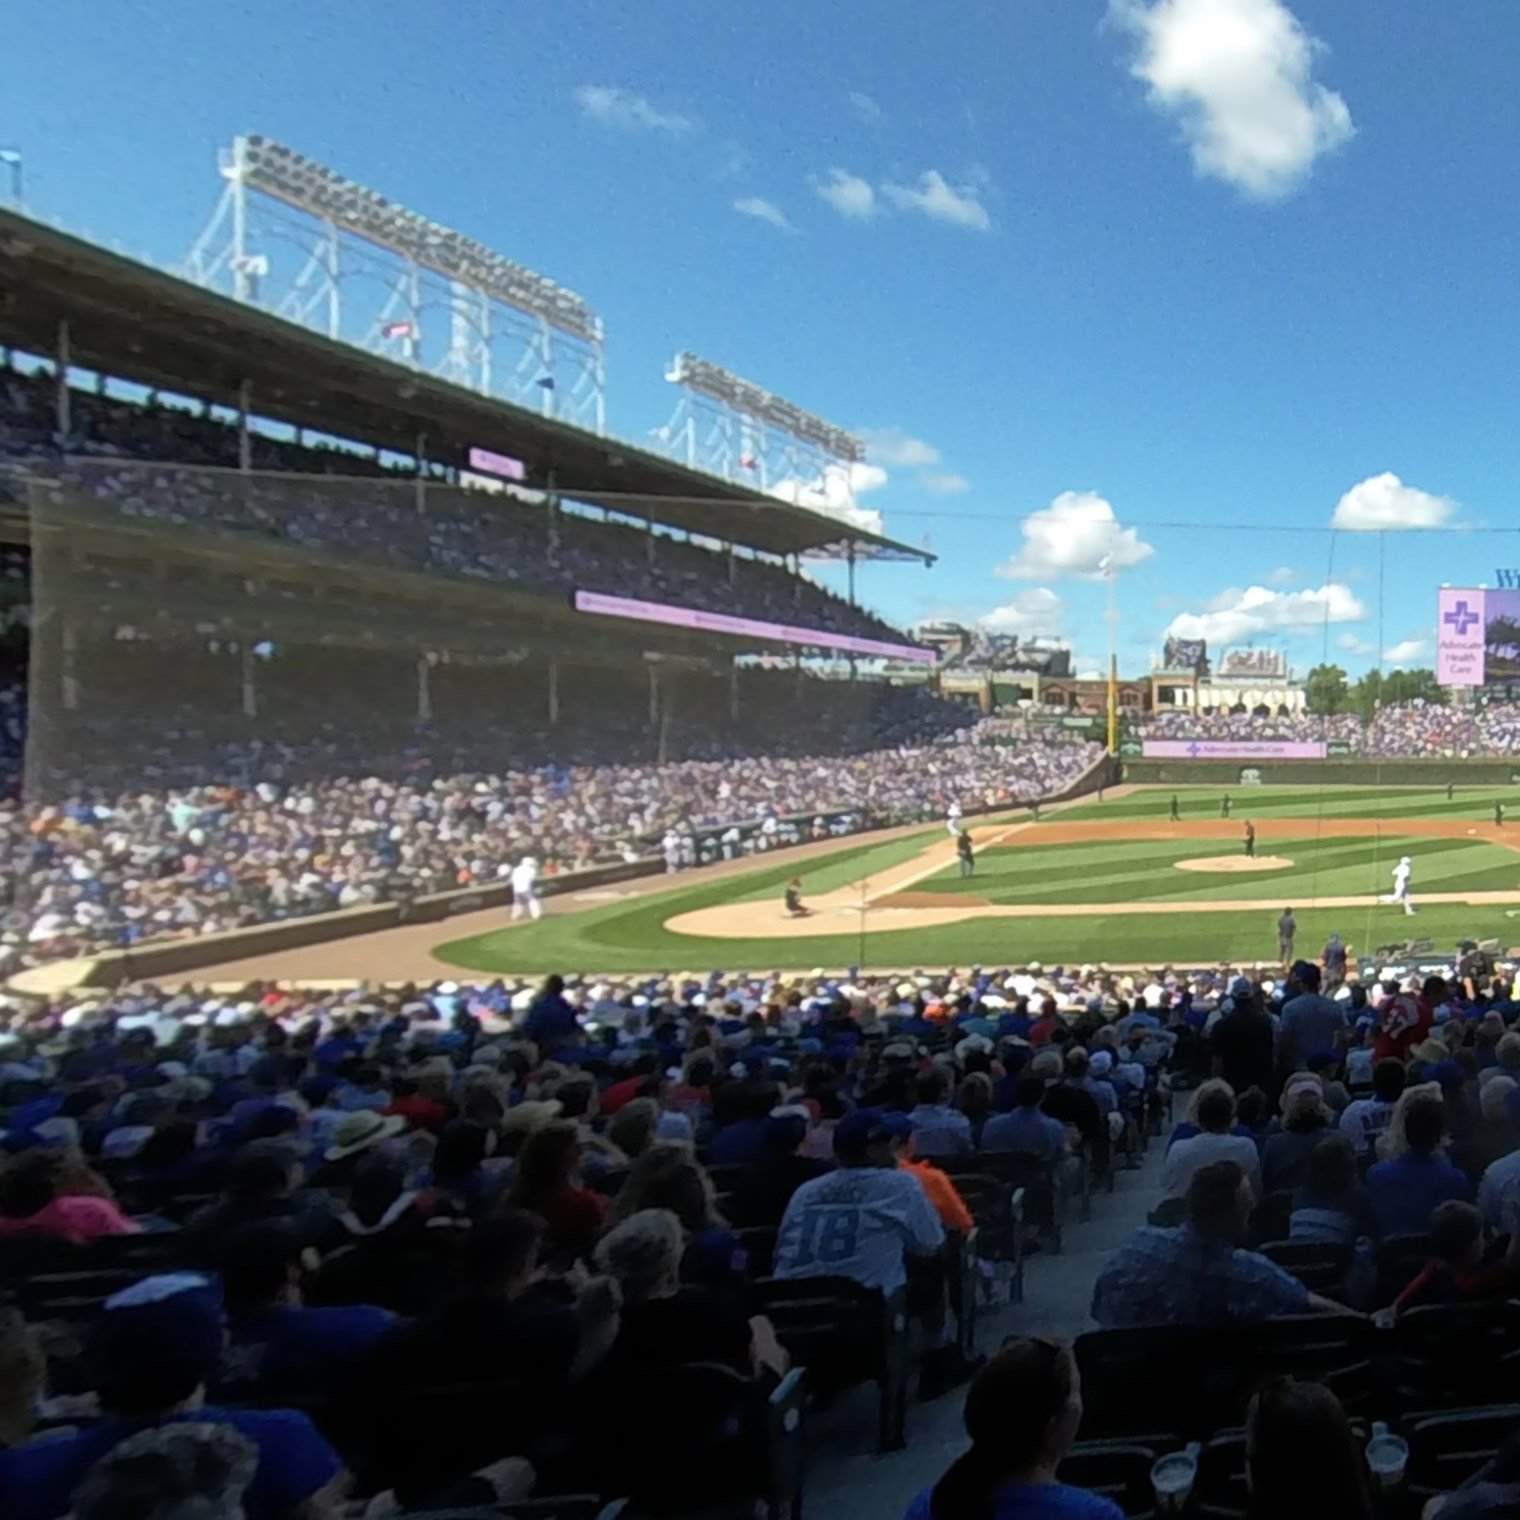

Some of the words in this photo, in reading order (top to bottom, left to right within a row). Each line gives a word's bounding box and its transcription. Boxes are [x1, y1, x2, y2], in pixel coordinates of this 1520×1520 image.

[1440, 640, 1482, 650] Advocate
[1445, 653, 1476, 663] Health
[1450, 664, 1472, 675] Care
[793, 1209, 860, 1267] 18
